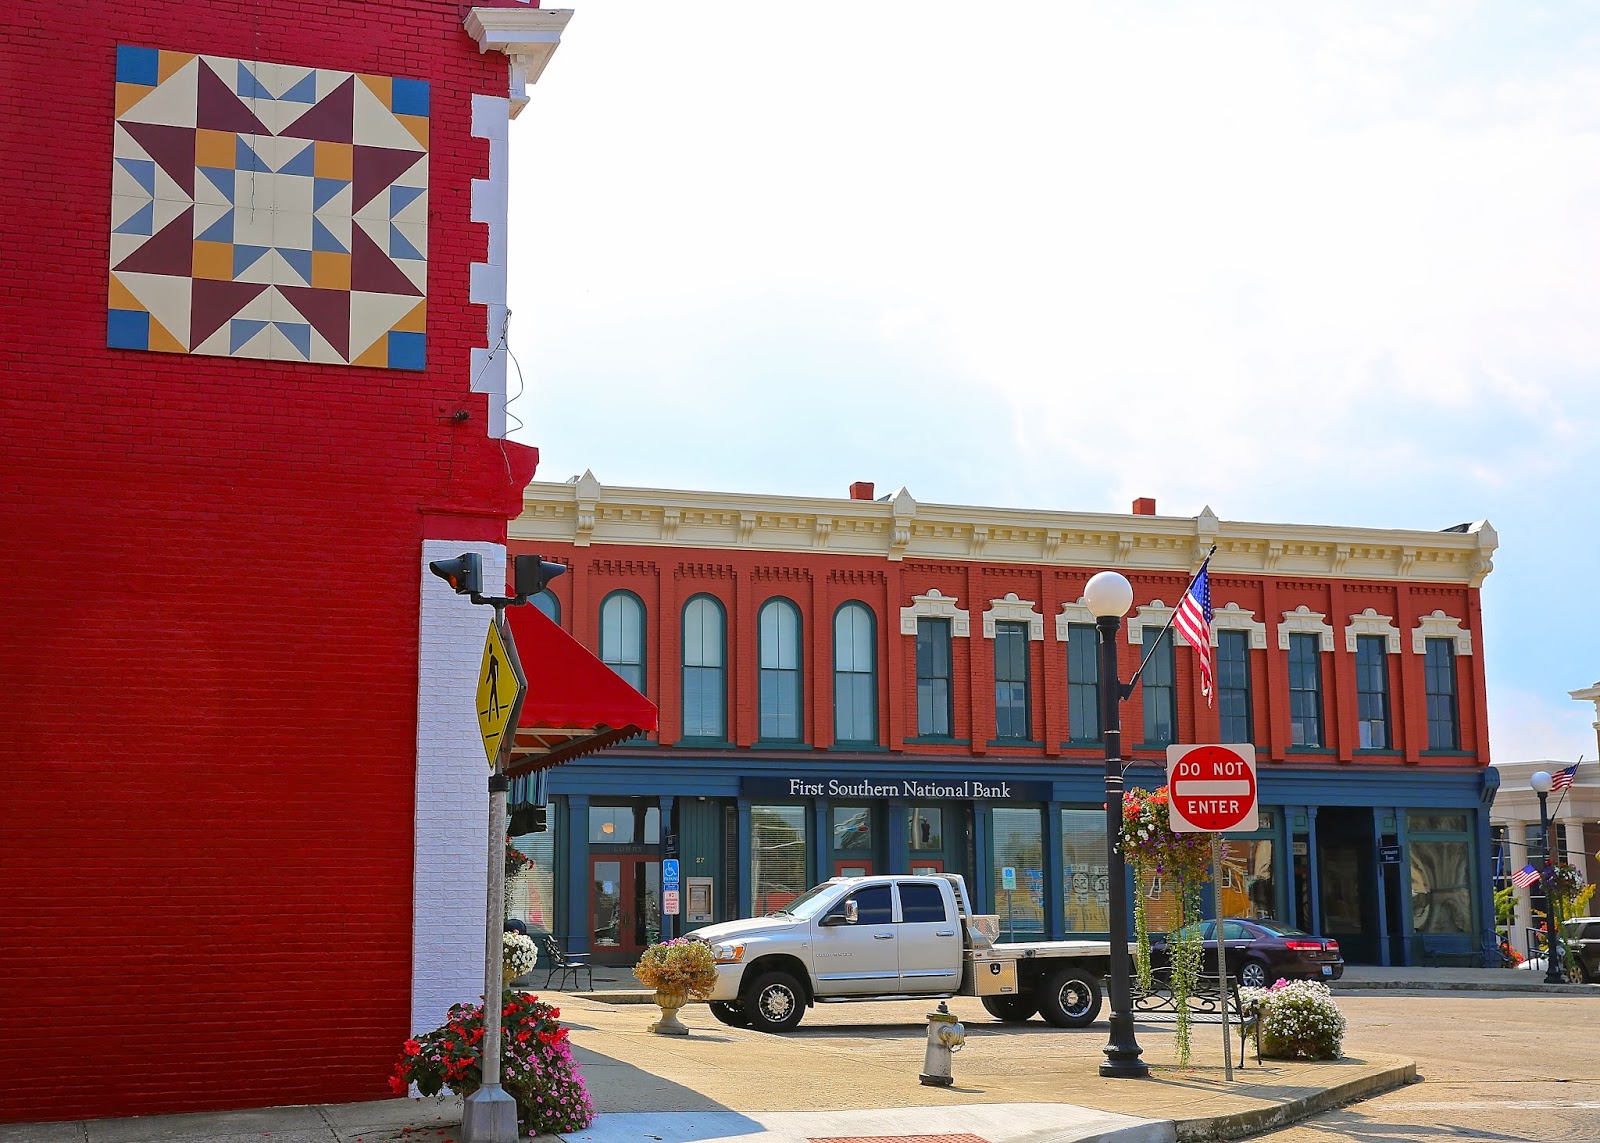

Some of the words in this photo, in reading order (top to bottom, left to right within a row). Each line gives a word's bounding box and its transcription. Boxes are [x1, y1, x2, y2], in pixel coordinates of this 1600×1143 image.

[1179, 762, 1201, 776] DO
[1213, 762, 1244, 776] NOT
[789, 779, 824, 796] First
[828, 779, 900, 797] Southern
[902, 780, 969, 798] National
[972, 782, 1011, 798] Bank
[1187, 800, 1240, 814] ENTER
